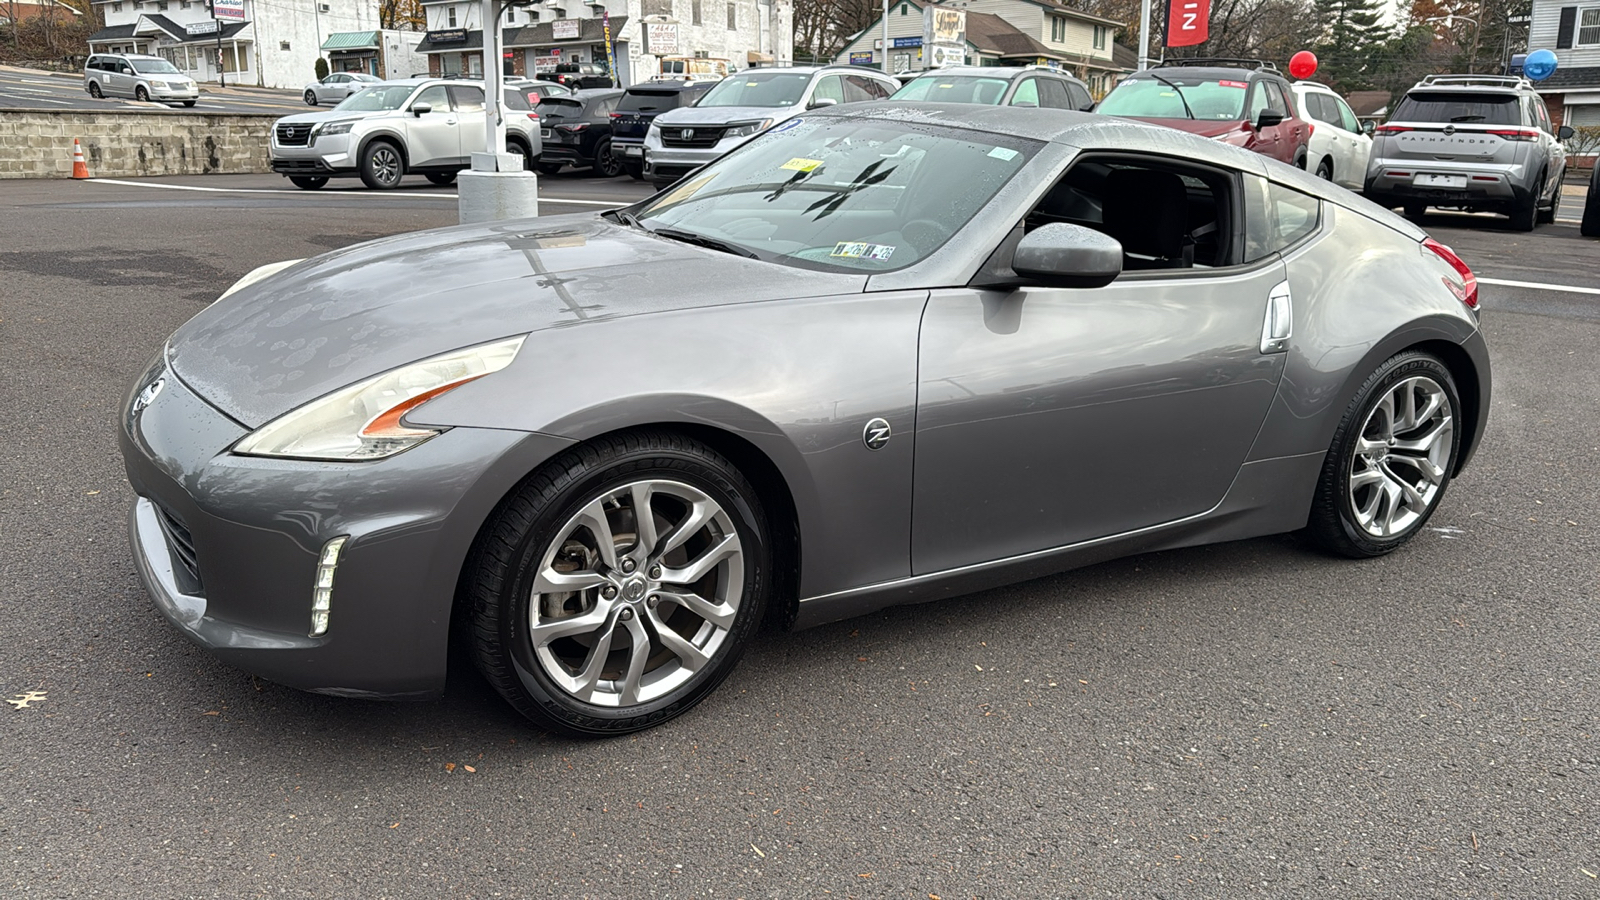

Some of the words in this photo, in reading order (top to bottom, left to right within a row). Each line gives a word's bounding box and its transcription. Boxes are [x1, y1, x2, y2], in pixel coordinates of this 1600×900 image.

[536, 57, 559, 66] COMPUTERS
[1401, 136, 1496, 145] PATHFINDER
[868, 427, 889, 443] Z
[602, 457, 741, 500] ASSURANCE
